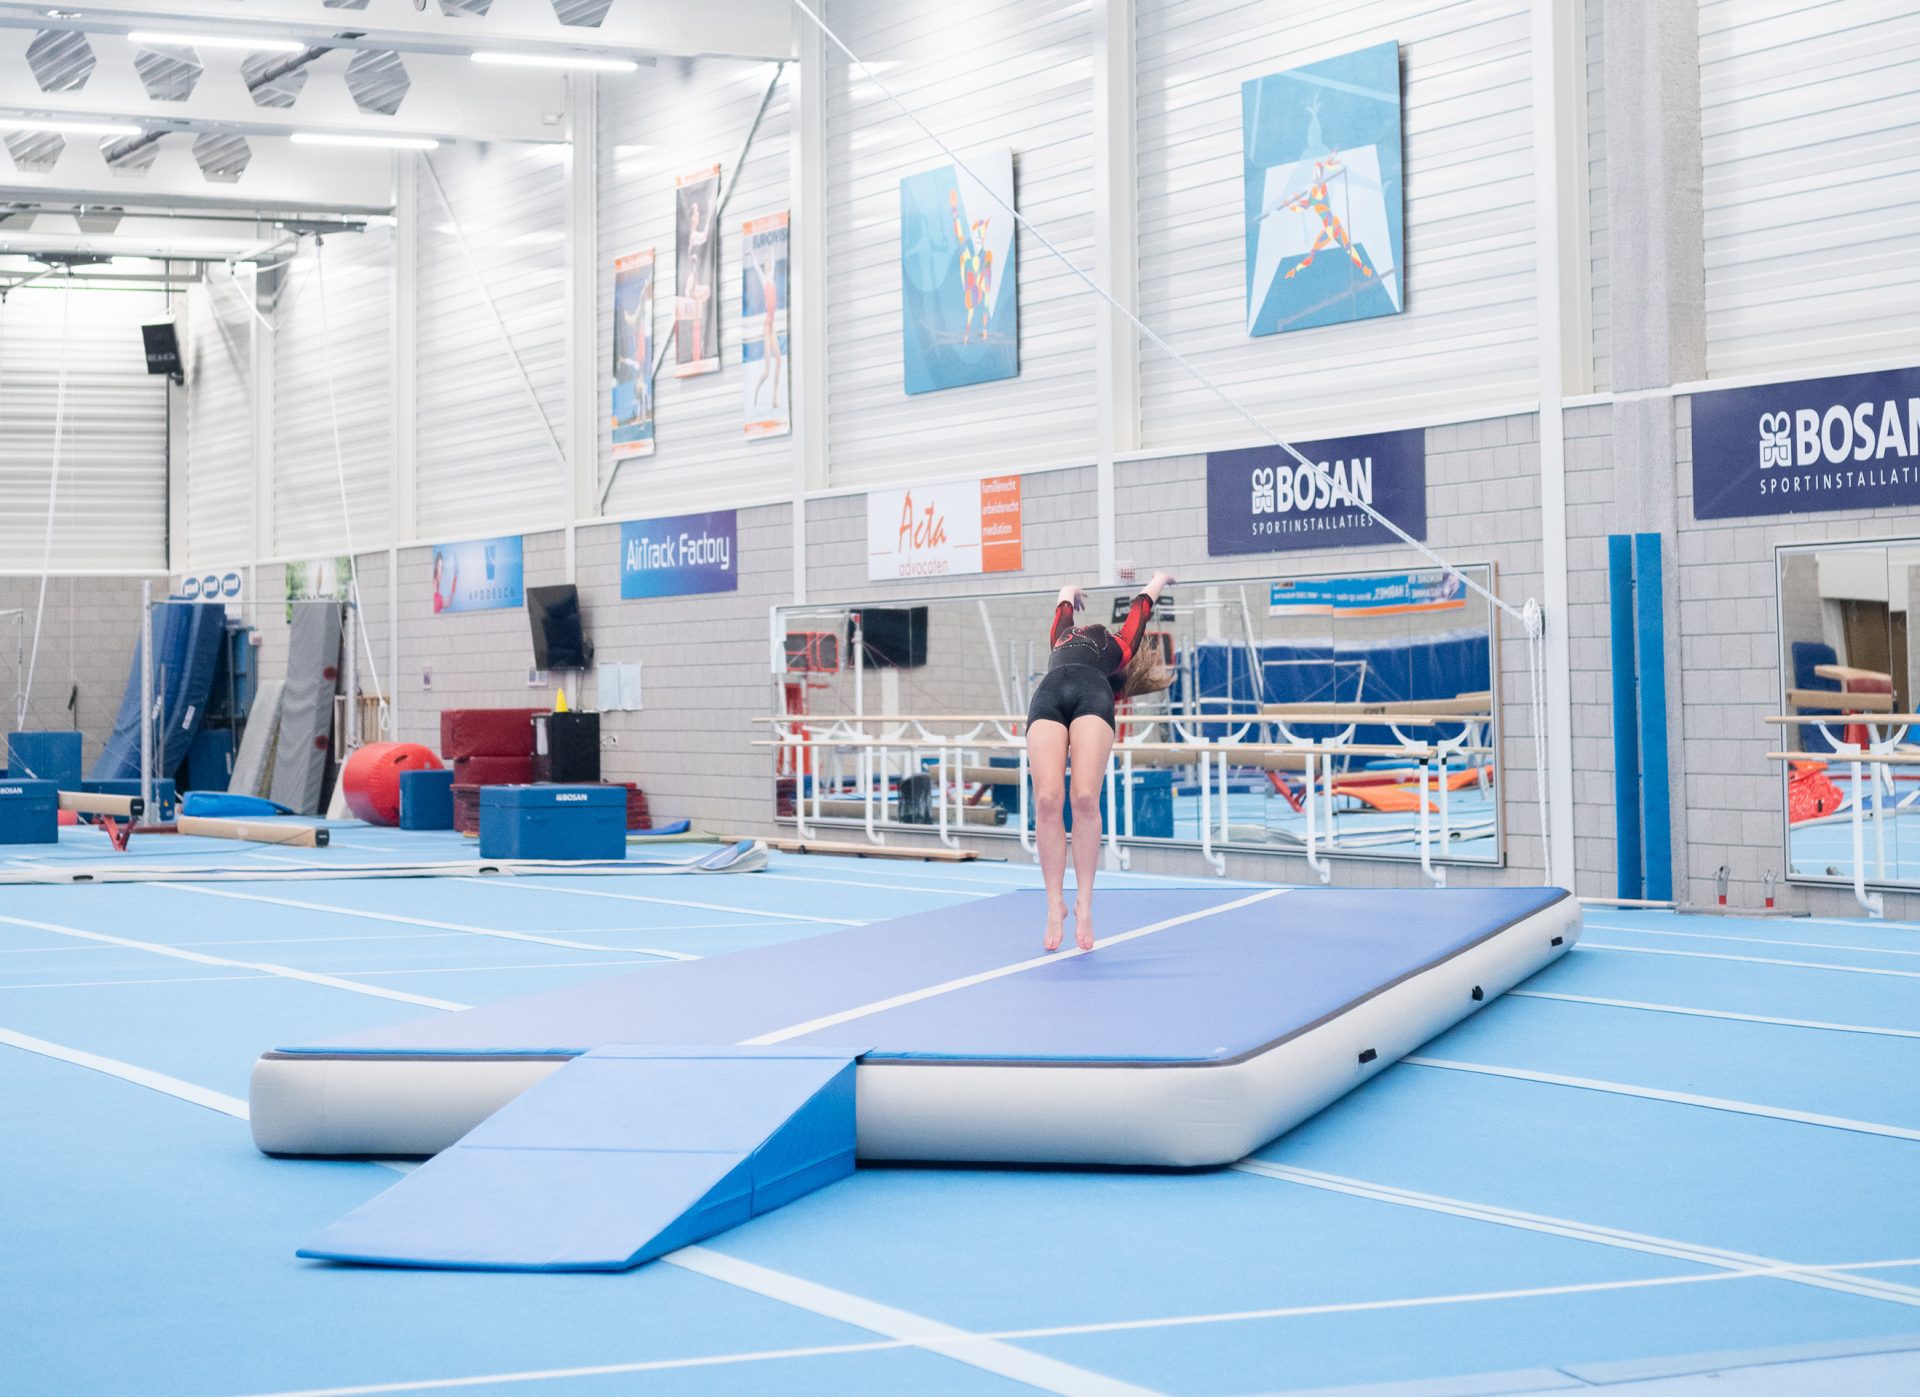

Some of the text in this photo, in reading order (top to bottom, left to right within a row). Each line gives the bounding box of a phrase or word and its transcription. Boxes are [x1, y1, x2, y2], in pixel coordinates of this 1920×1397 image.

[1276, 457, 1373, 513] BOSAN
[898, 490, 947, 554] Acta
[1252, 513, 1374, 536] SPORTINSTALLATIES
[626, 531, 730, 572] AirTrack Factory
[898, 556, 949, 577] advocaten
